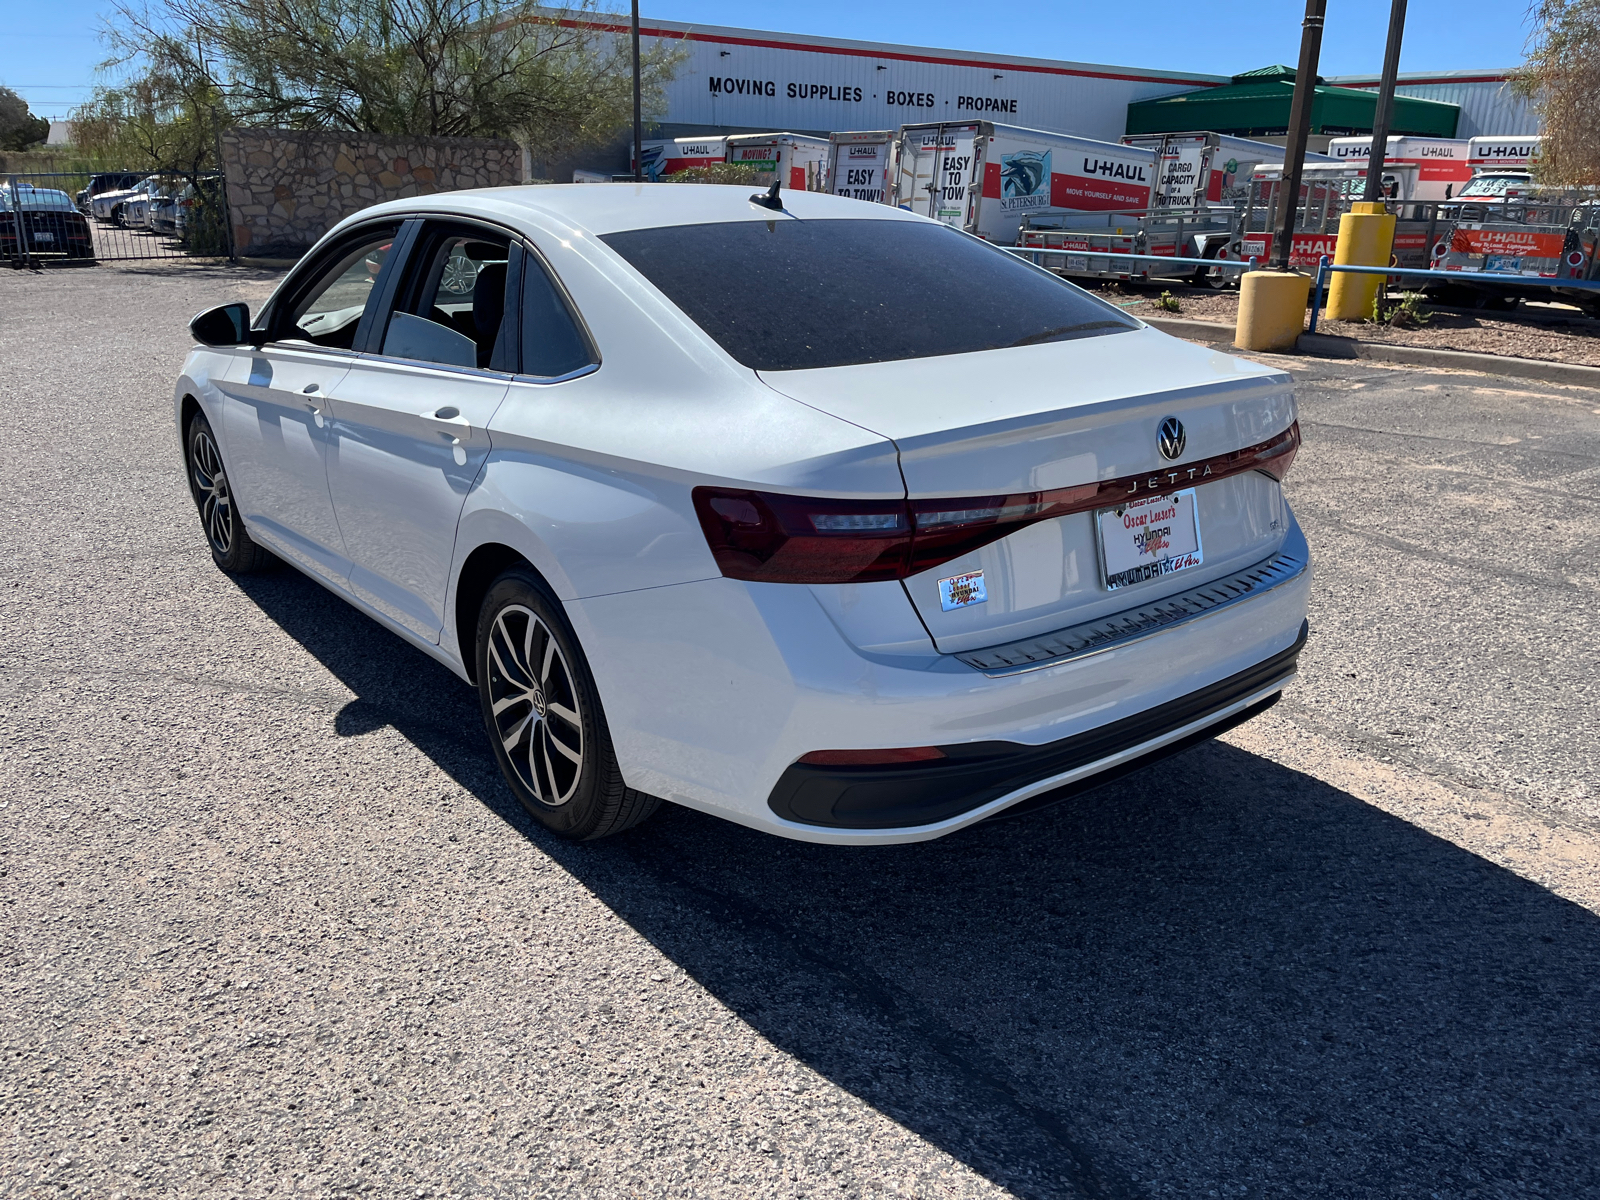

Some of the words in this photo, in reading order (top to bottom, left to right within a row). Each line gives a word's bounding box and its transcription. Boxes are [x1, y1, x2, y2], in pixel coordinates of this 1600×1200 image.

[709, 77, 776, 97] MOVING
[787, 83, 862, 102] SUPPLIES
[887, 91, 934, 108] BOXES
[958, 96, 1017, 113] PROPANE
[682, 145, 710, 155] U-HAUL
[741, 148, 772, 160] MOVING?
[850, 147, 877, 155] U-HAUL
[1421, 147, 1454, 158] U-HAUL
[943, 156, 970, 171] EASY
[1168, 162, 1192, 173] CARGO
[1084, 158, 1146, 182] U-HAUL
[847, 169, 874, 185] EASY
[948, 172, 960, 186] TO
[1161, 175, 1196, 184] CAPACITY
[942, 186, 965, 200] TOW
[1066, 188, 1083, 196] MOVE
[1084, 190, 1112, 200] YOURSELF
[1008, 195, 1046, 208] PETERSBURG
[1168, 196, 1192, 206] TRUCK
[1479, 232, 1536, 244] U-HAUL
[1062, 240, 1088, 250] U-HAUL
[1128, 465, 1212, 493] JETTA
[1124, 514, 1148, 529] Oscar
[1150, 506, 1176, 524] Leeser's
[1134, 526, 1171, 544] HYUNDAI
[1174, 556, 1184, 570] El
[1184, 554, 1200, 568] Paso
[951, 586, 979, 598] HYUNDAI
